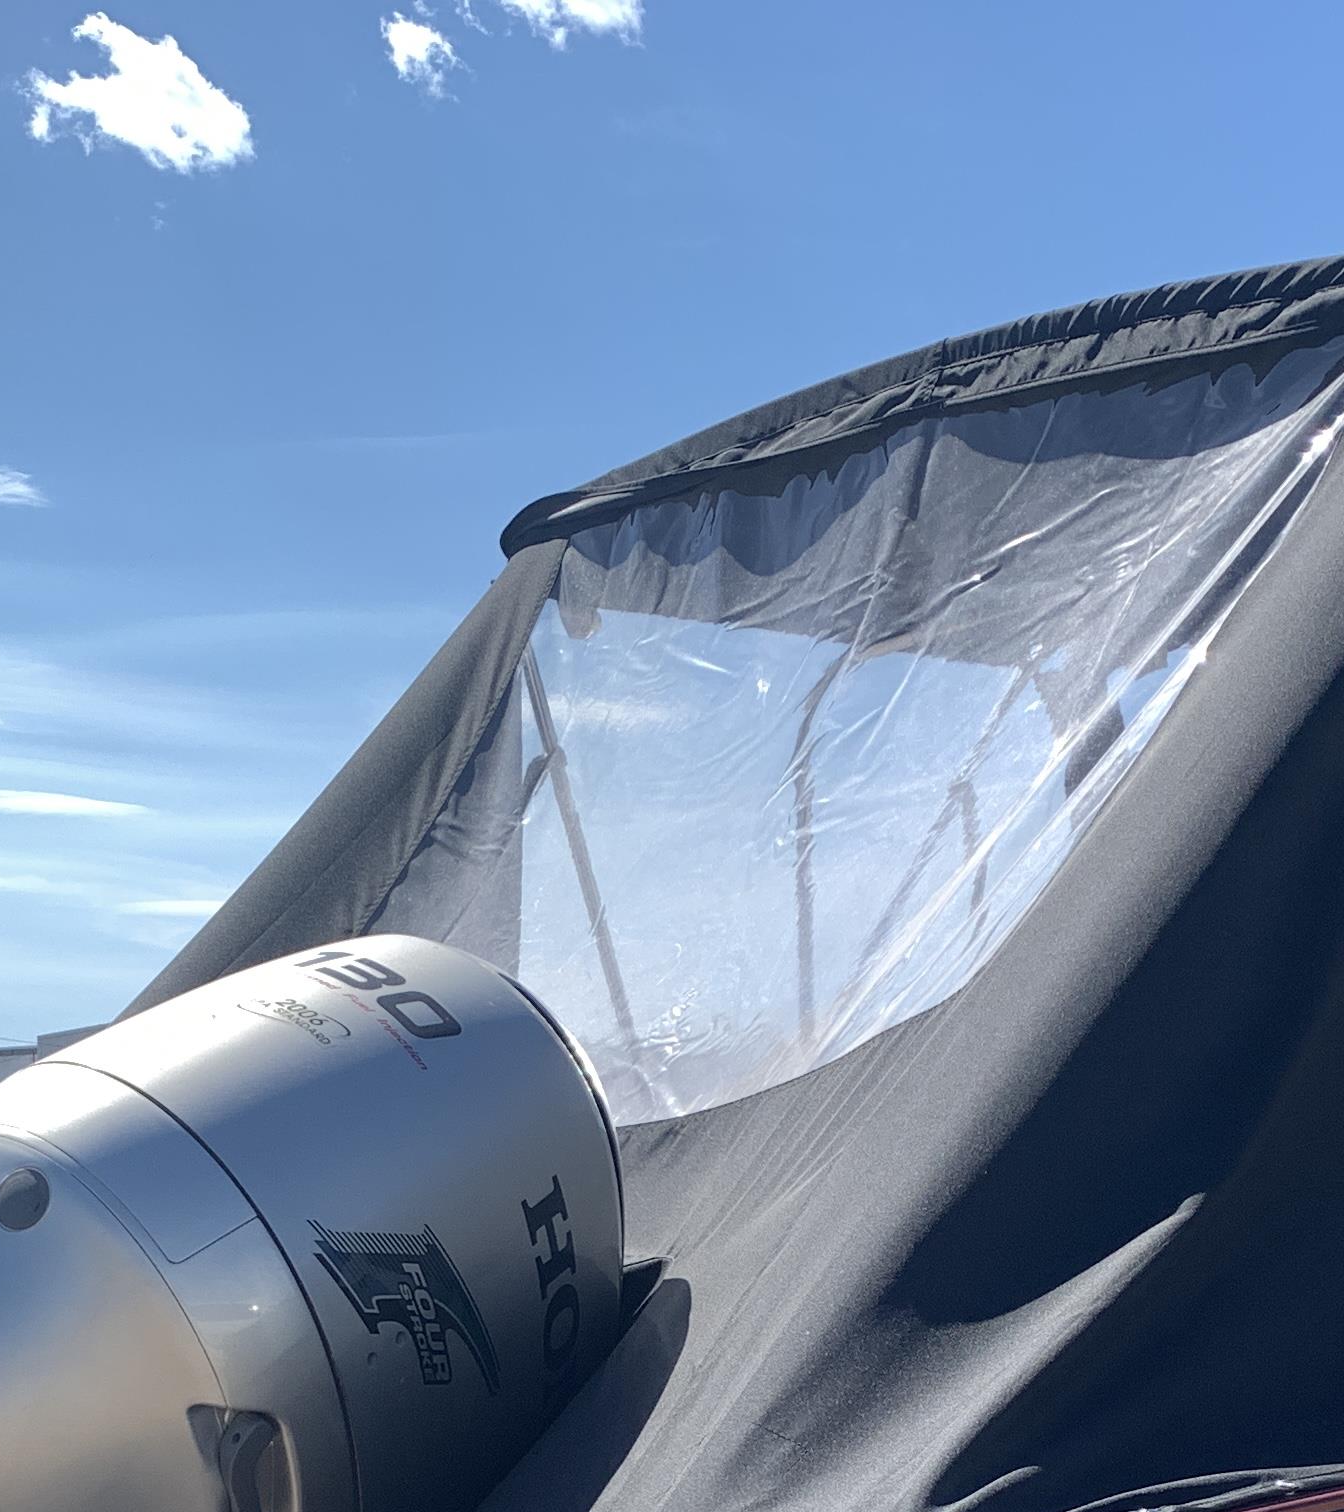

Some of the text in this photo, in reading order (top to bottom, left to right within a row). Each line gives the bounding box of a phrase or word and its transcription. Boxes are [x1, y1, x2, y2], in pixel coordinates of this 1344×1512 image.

[273, 1007, 332, 1045] STANDARD
[275, 998, 329, 1027] 2006
[294, 951, 462, 1039] 130
[376, 1017, 428, 1071] Injection
[520, 1174, 580, 1372] HO
[399, 1283, 435, 1382] STROKE
[402, 1262, 452, 1383] FOUR
